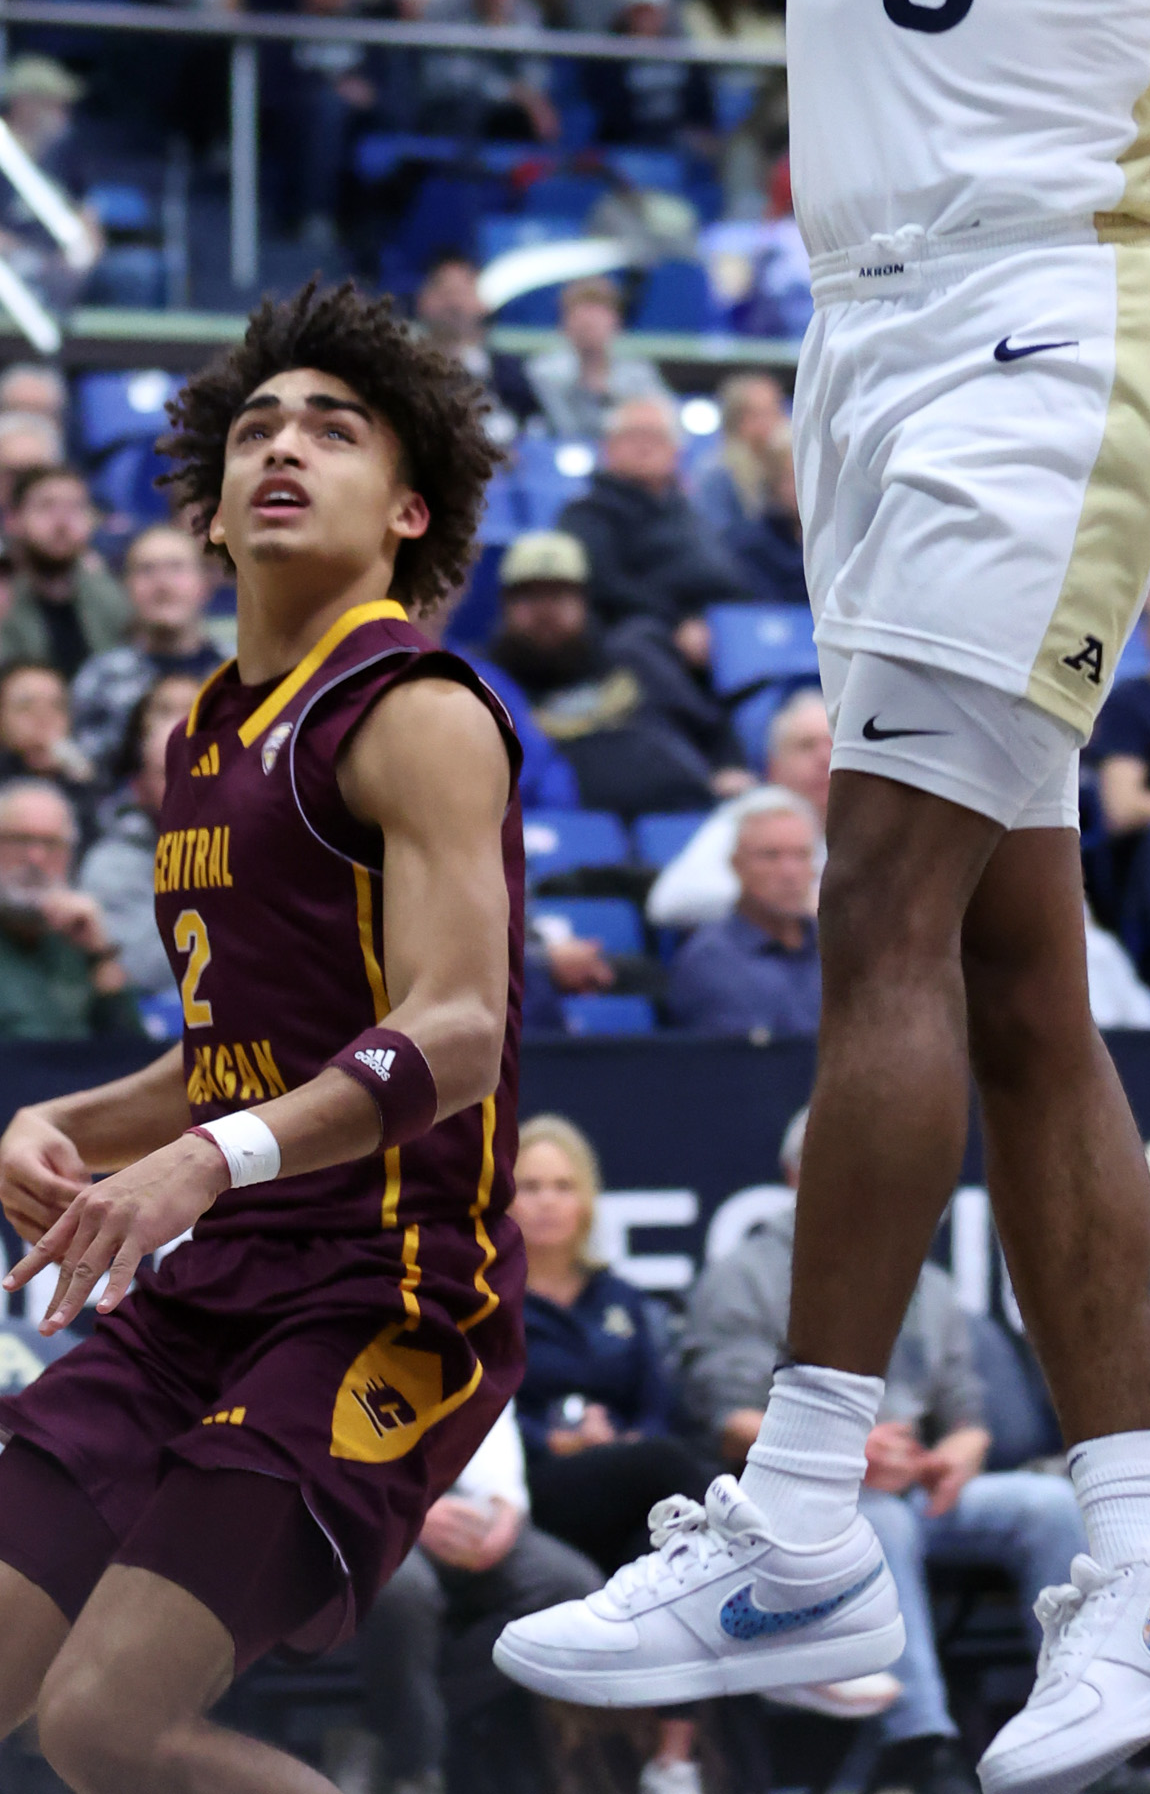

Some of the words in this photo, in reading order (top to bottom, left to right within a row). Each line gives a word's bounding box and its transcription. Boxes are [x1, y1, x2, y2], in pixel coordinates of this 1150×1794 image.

[859, 264, 904, 278] AKRON
[1062, 634, 1103, 685] A
[174, 909, 213, 1029] 2
[354, 1050, 391, 1082] adidas
